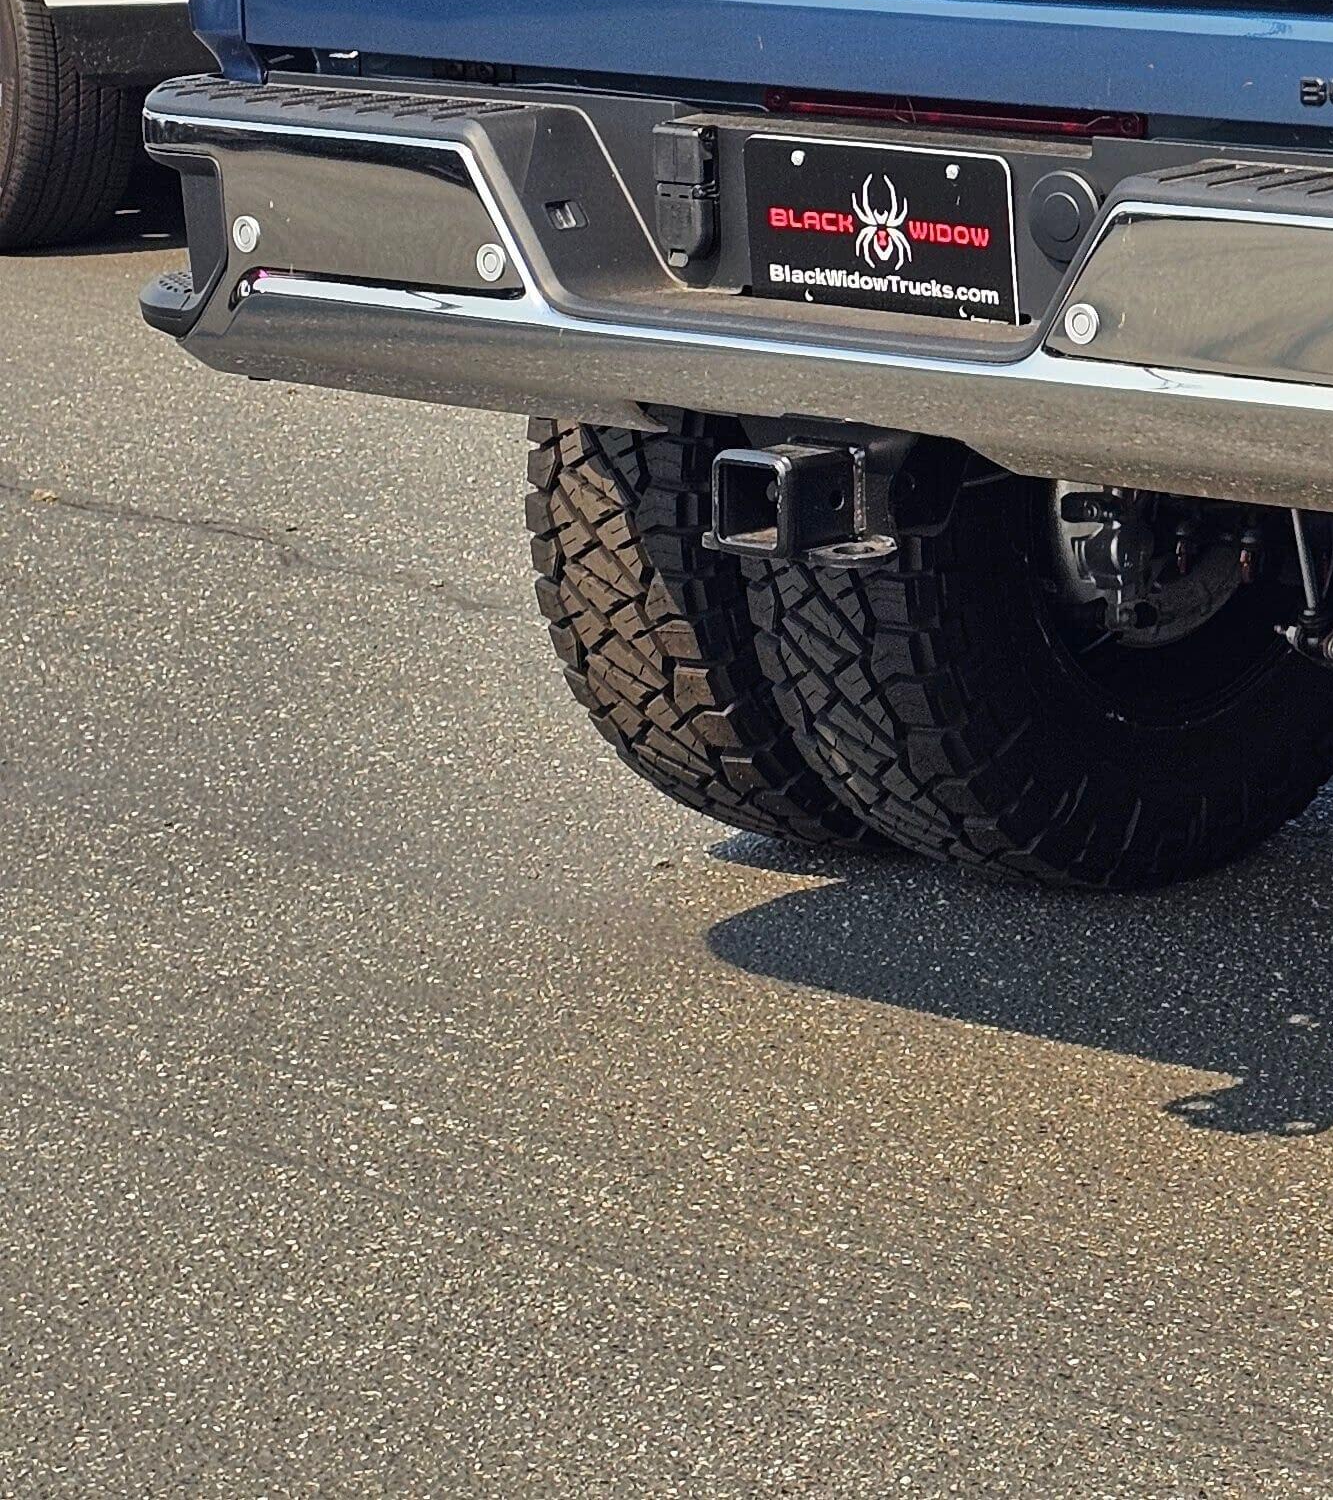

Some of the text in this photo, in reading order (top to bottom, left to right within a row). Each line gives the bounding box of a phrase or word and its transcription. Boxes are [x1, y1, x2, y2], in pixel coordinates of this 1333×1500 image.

[768, 207, 990, 247] BLACK WIDOW
[769, 264, 1000, 305] BlackWidowTrucks.com
